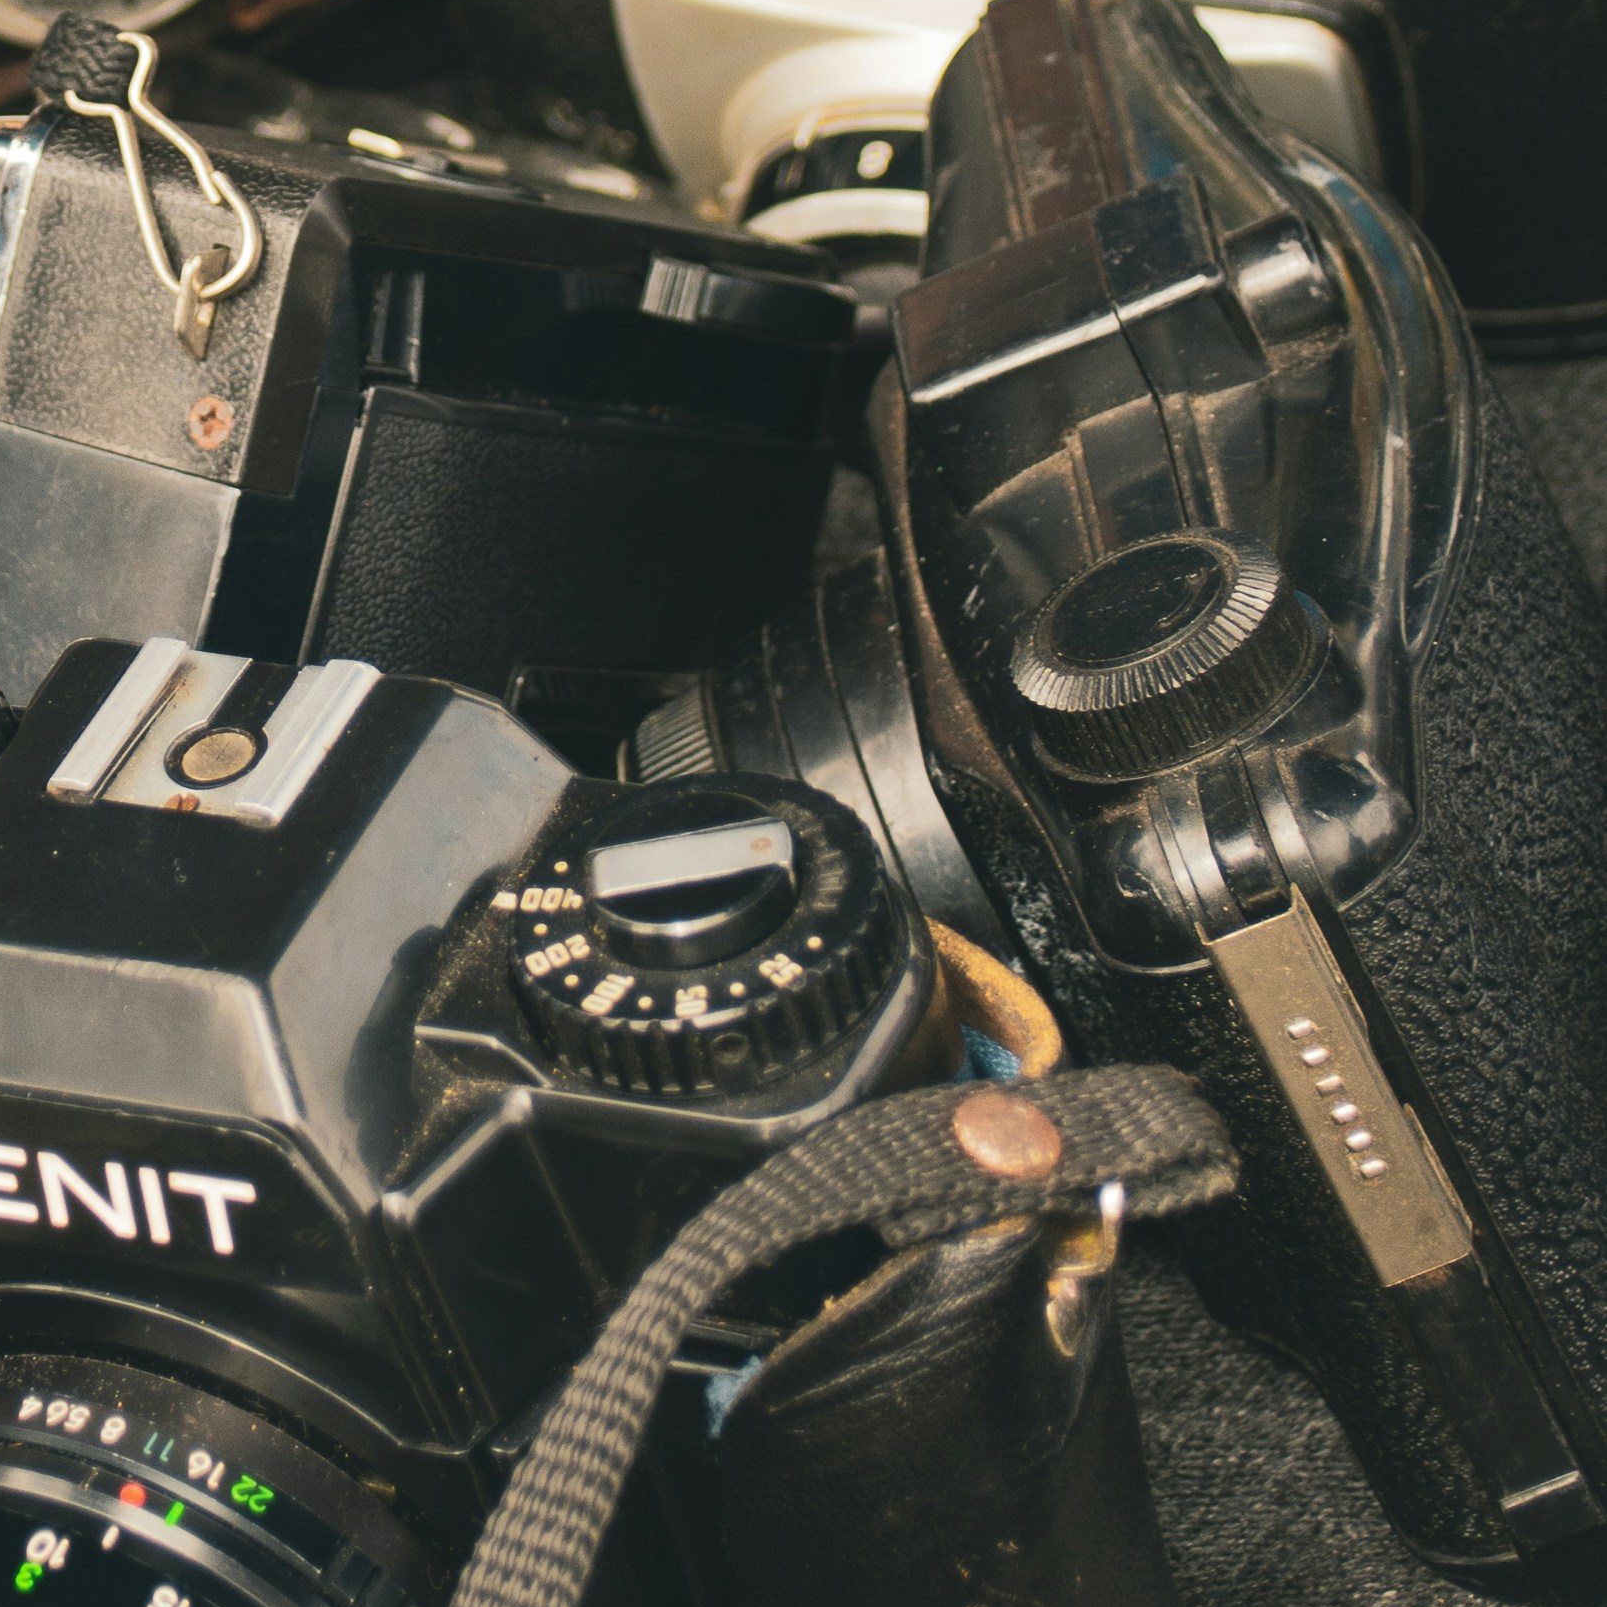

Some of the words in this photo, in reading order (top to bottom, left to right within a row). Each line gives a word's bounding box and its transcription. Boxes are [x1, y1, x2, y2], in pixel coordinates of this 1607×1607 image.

[520, 887, 584, 913] 400
[524, 934, 591, 977] 200
[758, 952, 804, 988] 25
[581, 974, 635, 1016] 100
[100, 1415, 128, 1446] 8
[141, 1430, 176, 1464] 11
[187, 1449, 227, 1491] 16
[230, 1474, 275, 1515] 22
[25, 1529, 71, 1571] 10
[14, 1562, 44, 1592] 3
